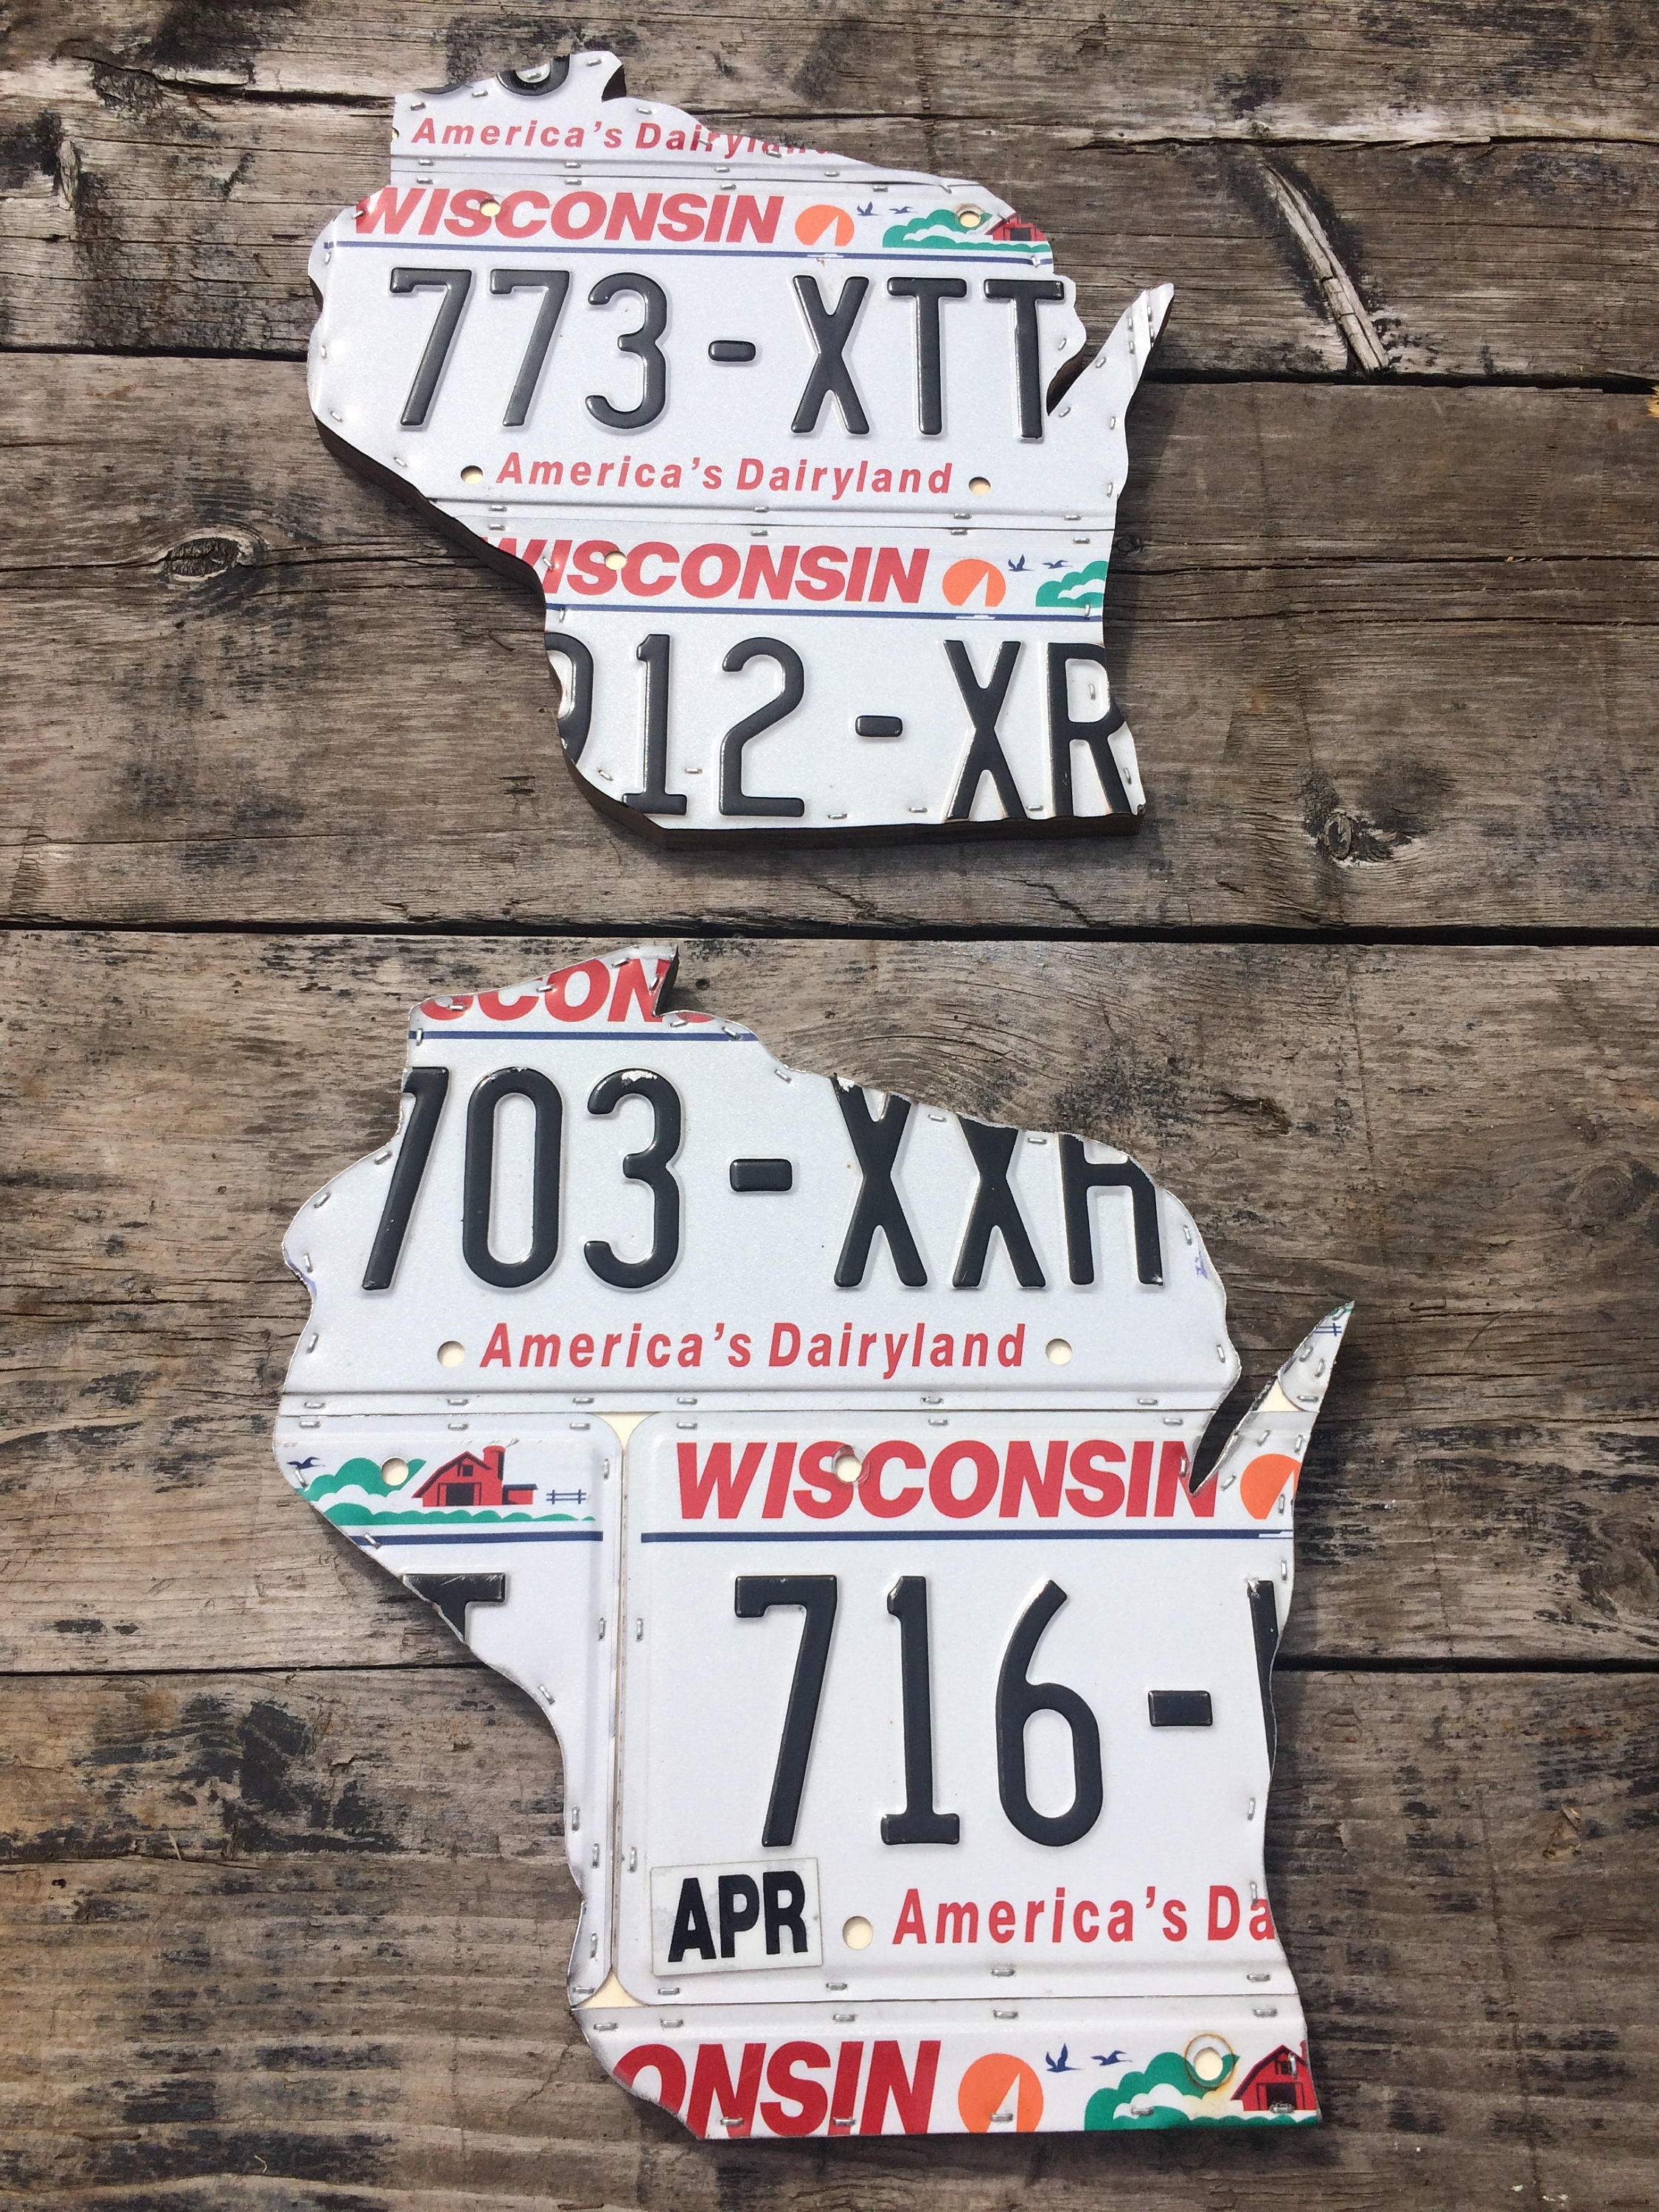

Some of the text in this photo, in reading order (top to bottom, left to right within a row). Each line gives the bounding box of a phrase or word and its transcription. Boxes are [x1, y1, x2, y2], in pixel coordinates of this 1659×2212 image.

[411, 117, 833, 159] America's Dairyl
[355, 187, 785, 244] WISCONSIN
[496, 452, 953, 501] America's Dairyland
[479, 1322, 1026, 1380] America's Dairyland
[676, 1439, 1218, 1520] WISCONSIN
[734, 1574, 1280, 1848] 716-
[667, 1870, 808, 1963] APR
[891, 1884, 1276, 1945] America's Da
